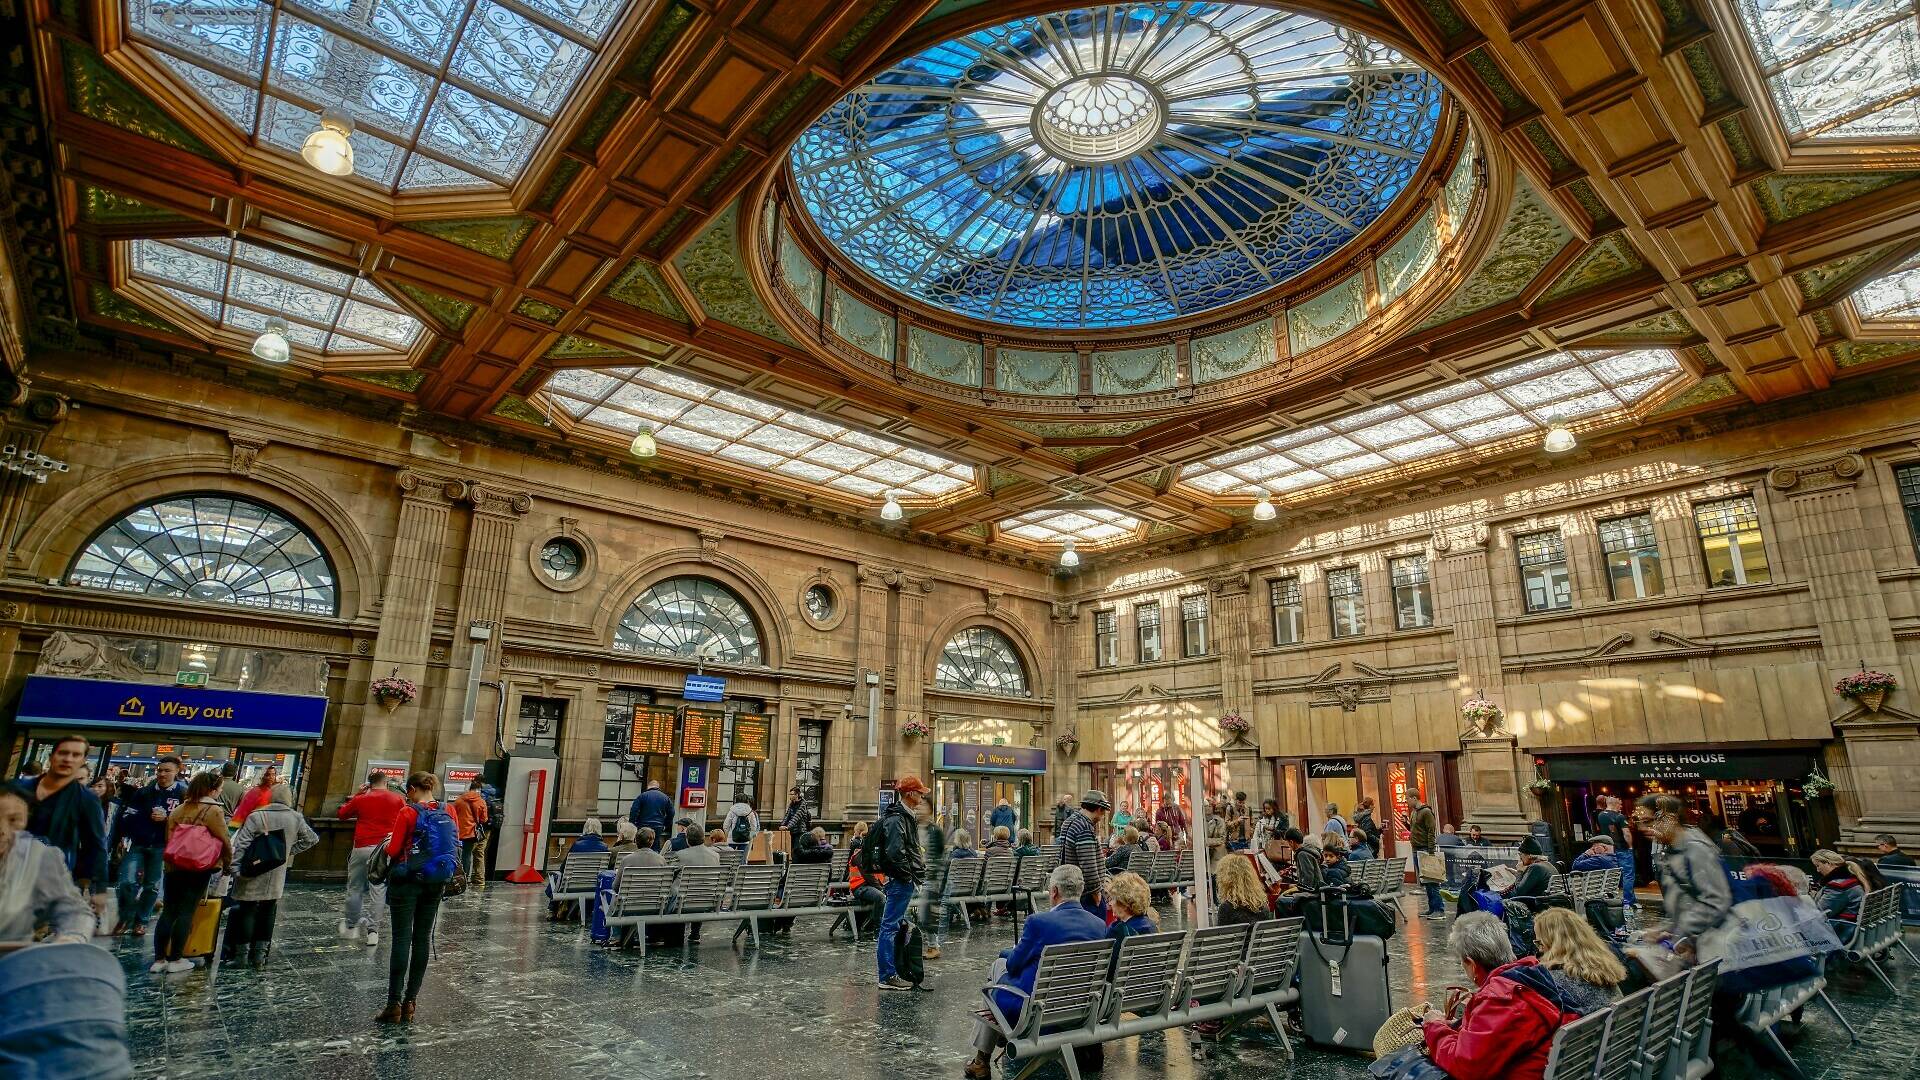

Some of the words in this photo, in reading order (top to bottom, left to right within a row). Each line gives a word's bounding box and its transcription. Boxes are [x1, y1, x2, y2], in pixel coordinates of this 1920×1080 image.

[160, 701, 199, 719] Way
[203, 707, 234, 719] out
[989, 754, 1003, 766] Way
[1004, 756, 1015, 765] out
[1611, 755, 1637, 765] THE
[1642, 754, 1676, 764] BEER
[1679, 754, 1726, 764] HOUSE
[1311, 762, 1353, 777] Paperchase
